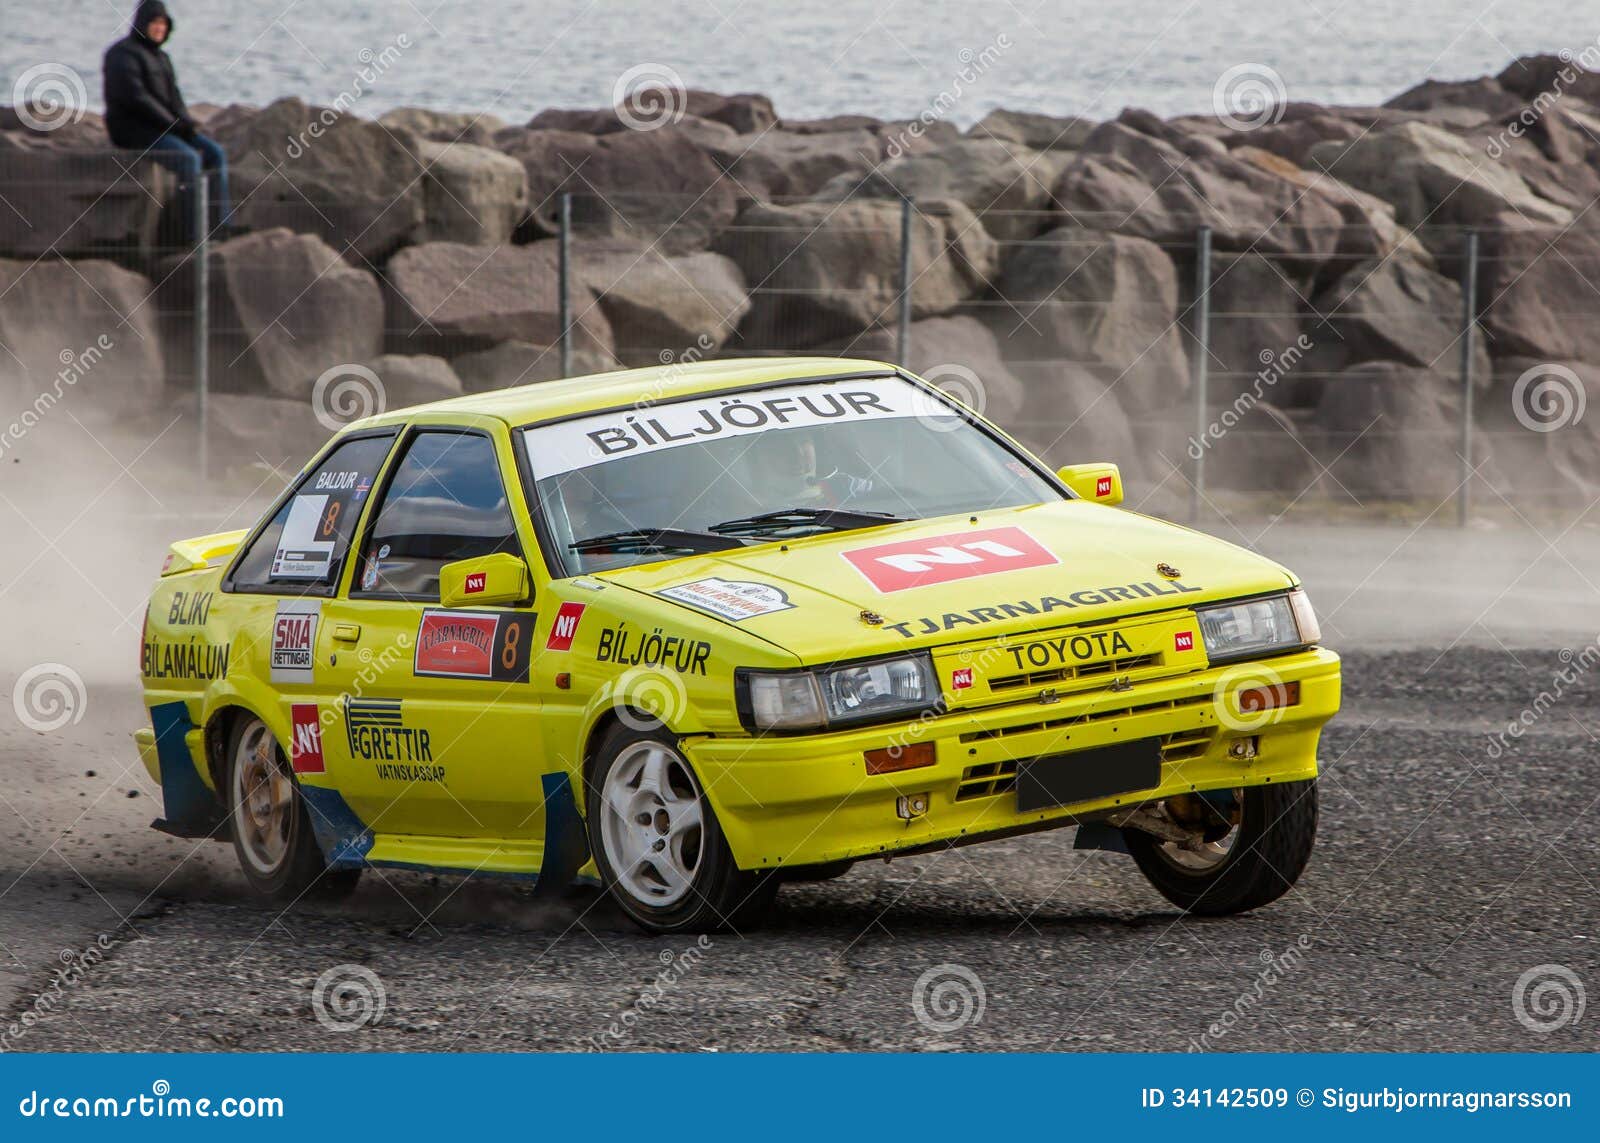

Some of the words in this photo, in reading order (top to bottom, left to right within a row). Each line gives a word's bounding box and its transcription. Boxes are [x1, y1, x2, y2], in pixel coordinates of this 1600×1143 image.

[586, 391, 895, 455] BÍLJÖFUR
[316, 472, 358, 489] BALDUR
[1098, 480, 1110, 492] N1
[323, 501, 341, 536] 8
[874, 539, 1028, 573] N1
[468, 578, 483, 589] N1
[168, 591, 214, 626] BLIKI
[882, 580, 1203, 639] TJARNAGRILL
[275, 615, 312, 649] SMÁ
[555, 616, 575, 638] N1
[1176, 637, 1192, 647] N1
[144, 635, 230, 680] BÍLAMÁLUN
[274, 652, 310, 665] RETTINGAR
[502, 622, 520, 670] 8
[596, 621, 713, 676] BÍLJÖFUR
[1006, 631, 1132, 670] TOYOTA
[955, 673, 971, 685] N1
[296, 723, 320, 754] N1
[357, 726, 433, 762] GRETTIR
